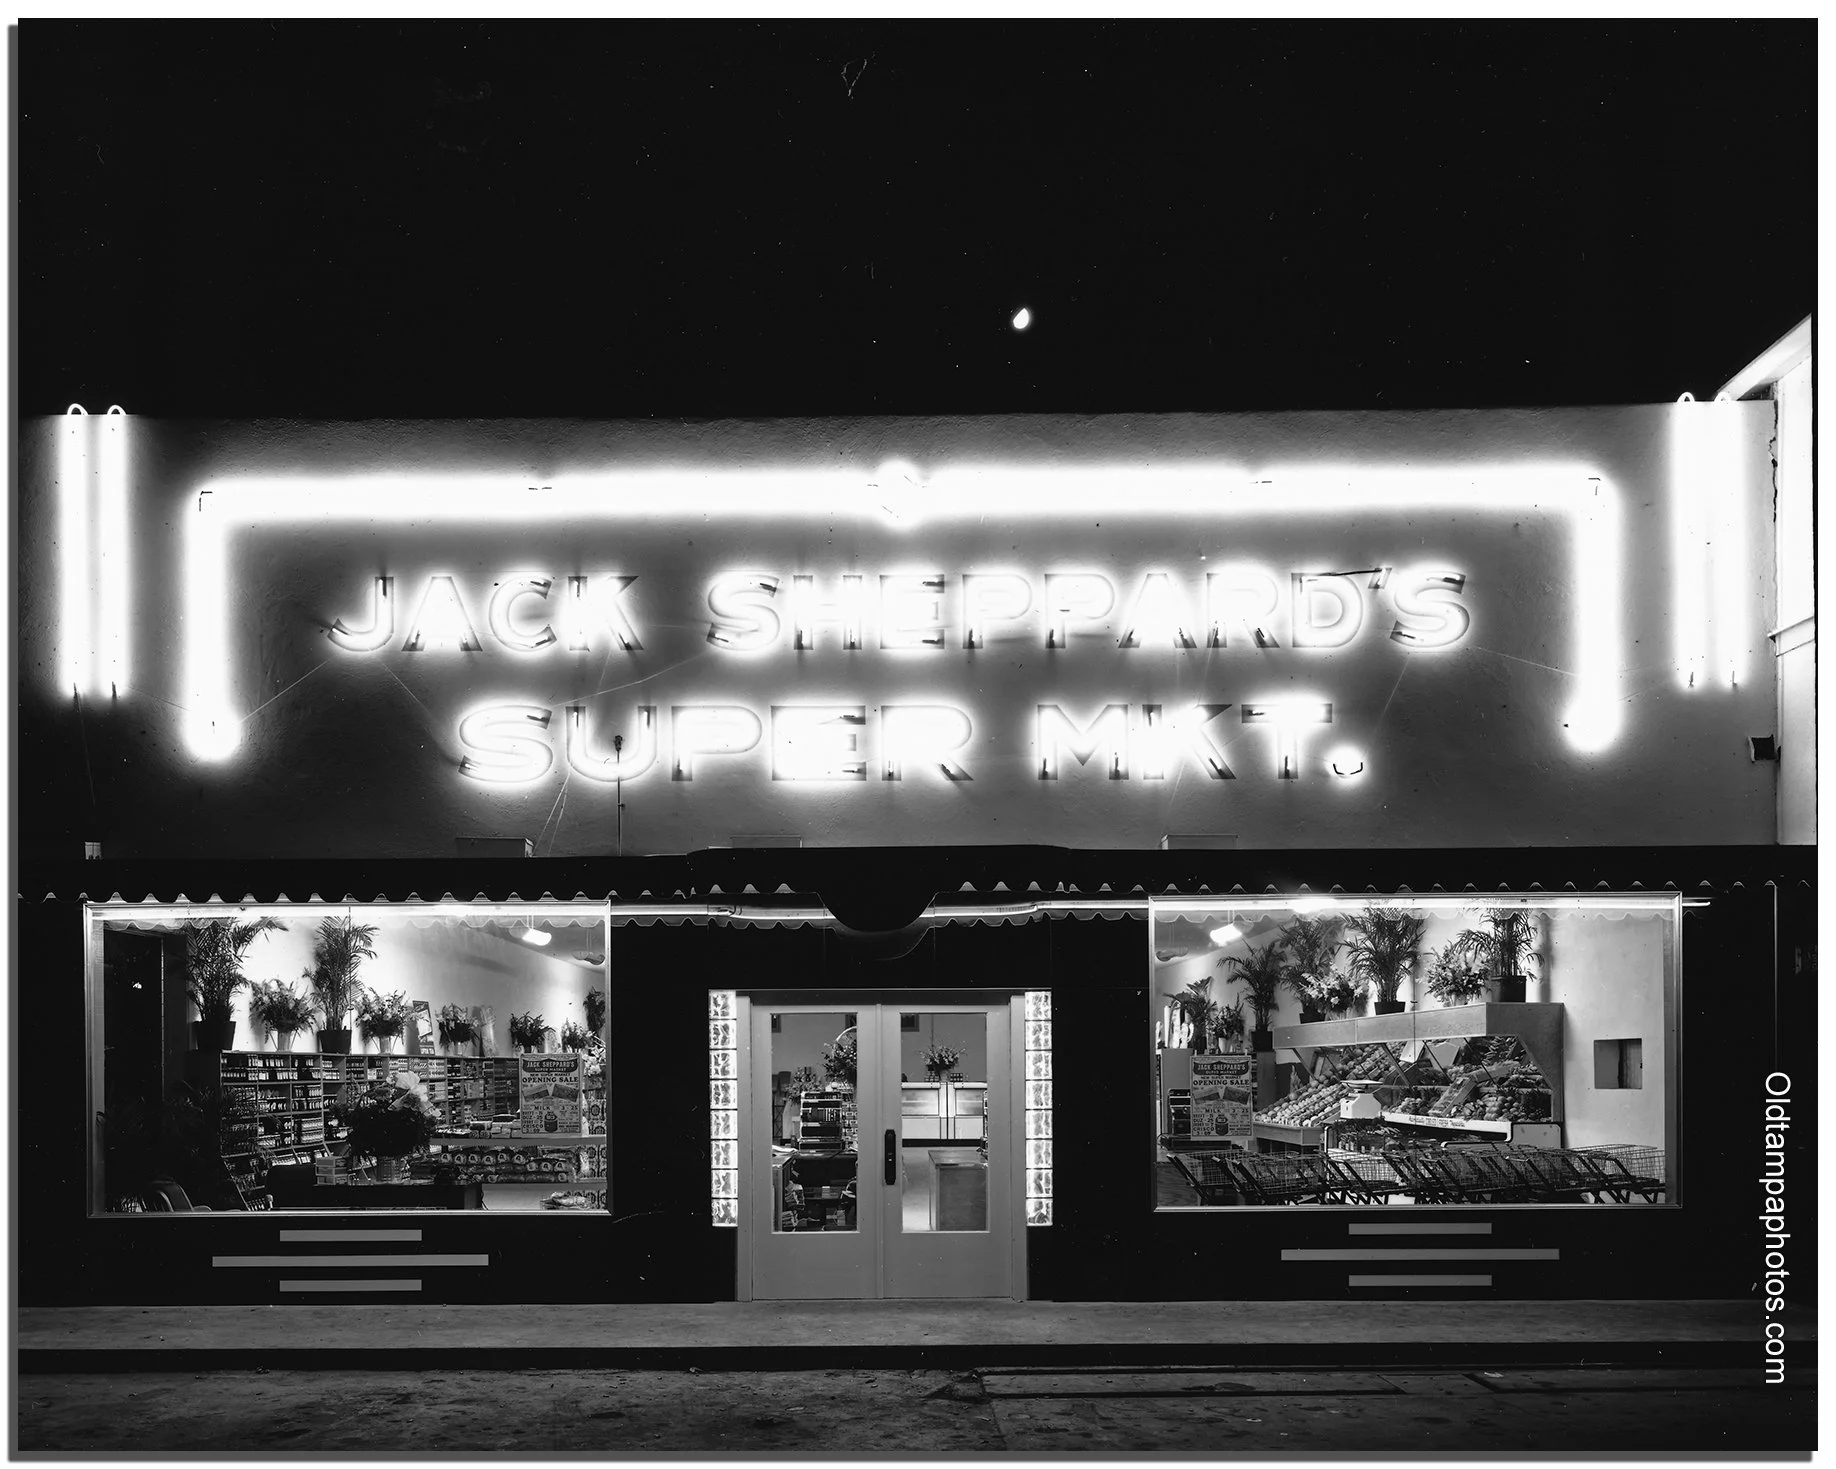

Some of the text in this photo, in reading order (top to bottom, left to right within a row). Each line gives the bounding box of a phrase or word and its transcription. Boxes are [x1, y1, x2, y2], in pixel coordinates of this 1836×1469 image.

[327, 568, 1471, 652] JACK SHEPPARD'S
[458, 703, 1366, 782] SUPER MKT.
